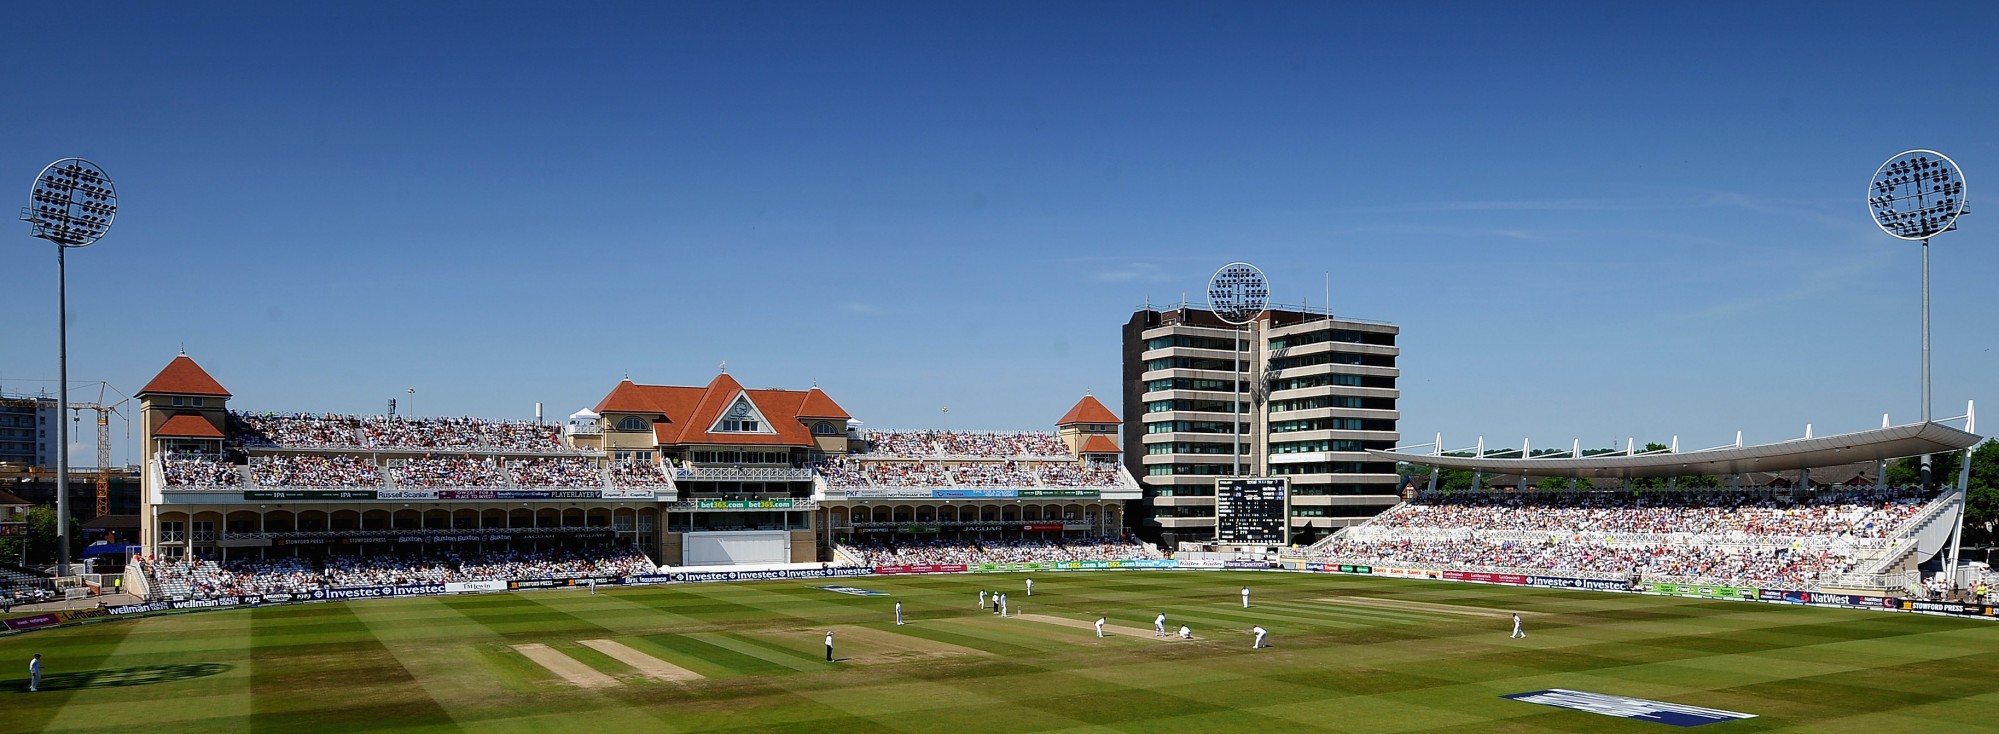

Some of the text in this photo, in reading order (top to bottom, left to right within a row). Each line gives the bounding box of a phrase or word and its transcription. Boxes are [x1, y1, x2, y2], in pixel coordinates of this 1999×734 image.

[787, 569, 825, 577] Investec
[1534, 577, 1573, 587] Investec
[1583, 581, 1626, 590] Investec
[325, 588, 380, 598] Investec
[394, 584, 445, 595] Investec
[1811, 593, 1850, 604] NatWest
[174, 600, 218, 609] wellman
[1913, 602, 1963, 612] STOWFORD PRESS
[108, 605, 150, 615] wellman
